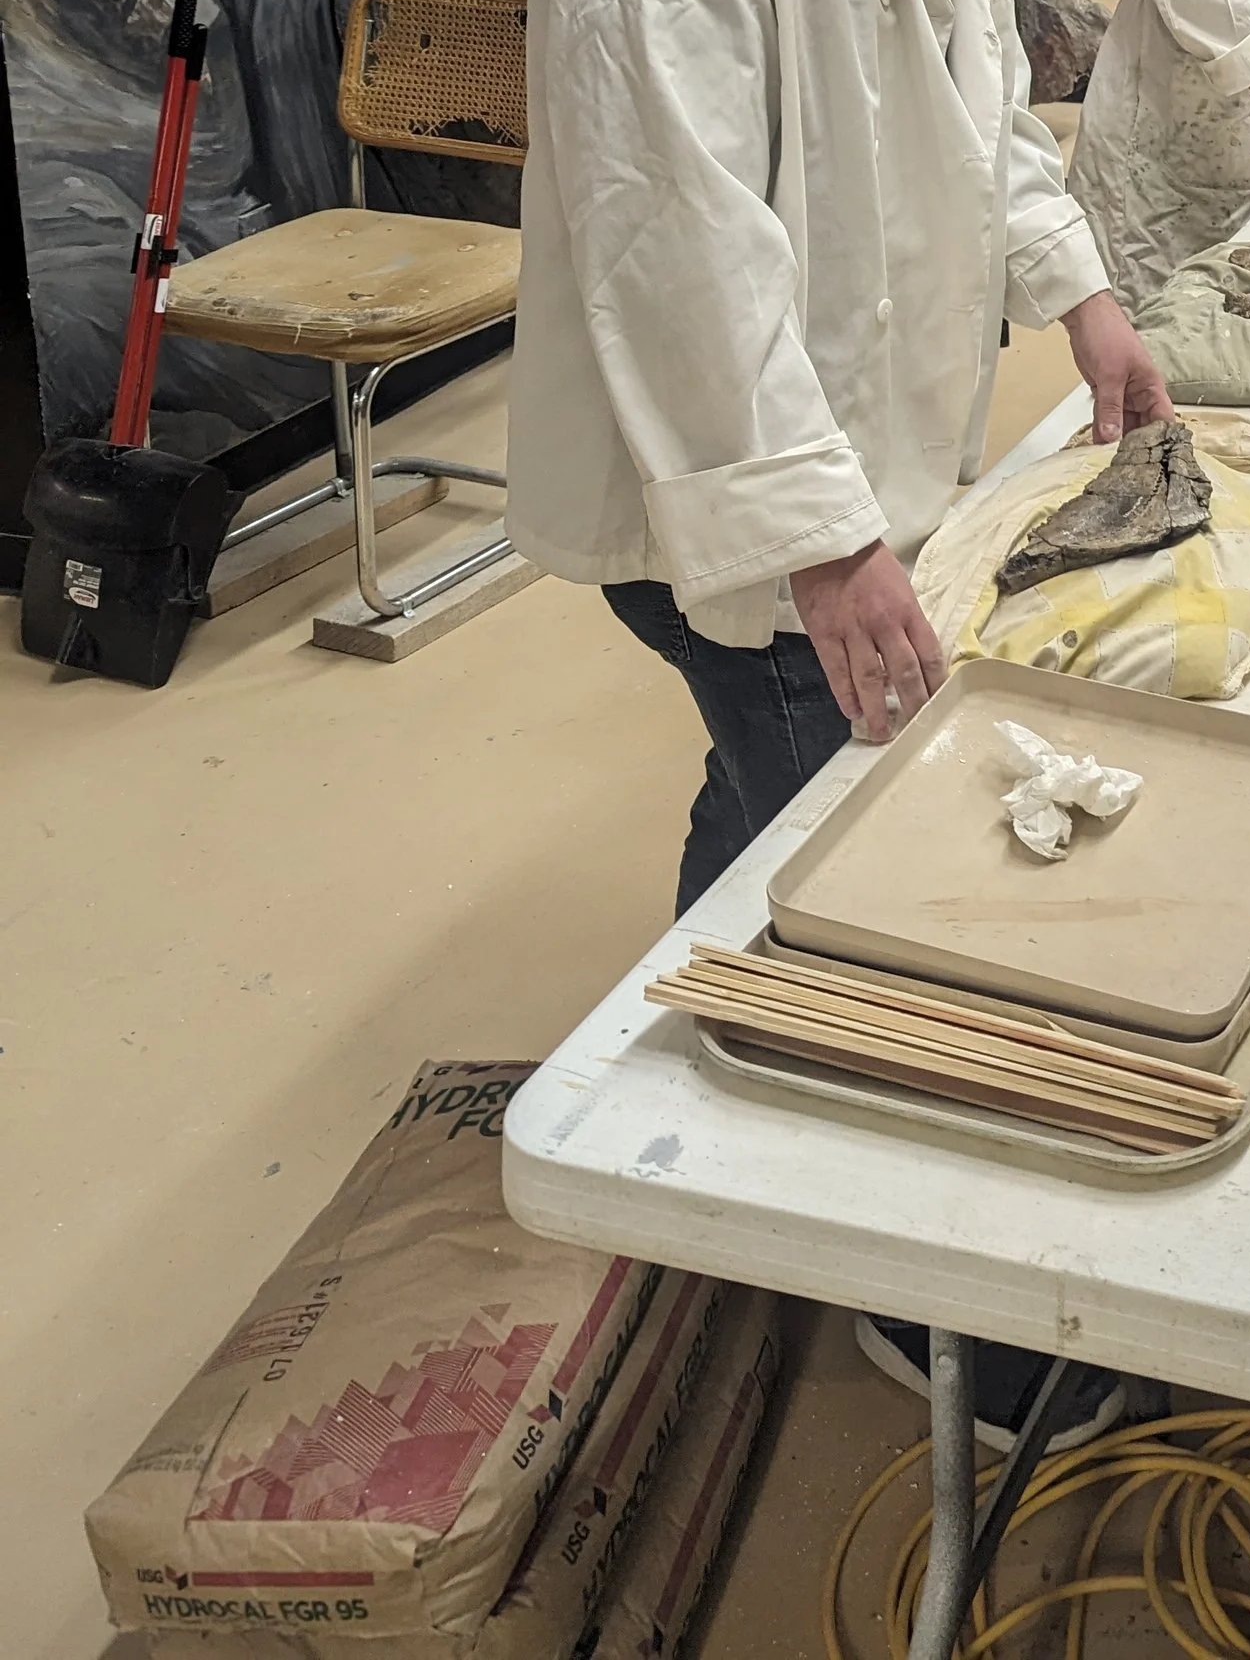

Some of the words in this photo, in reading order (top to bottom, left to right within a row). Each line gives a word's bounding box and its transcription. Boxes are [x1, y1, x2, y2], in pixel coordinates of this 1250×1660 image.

[512, 1425, 544, 1470] USG
[562, 1520, 590, 1565] USG
[137, 1568, 164, 1583] USG
[144, 1593, 275, 1620] HYDROCAL
[278, 1601, 331, 1622] FGR
[335, 1599, 369, 1621] 95
